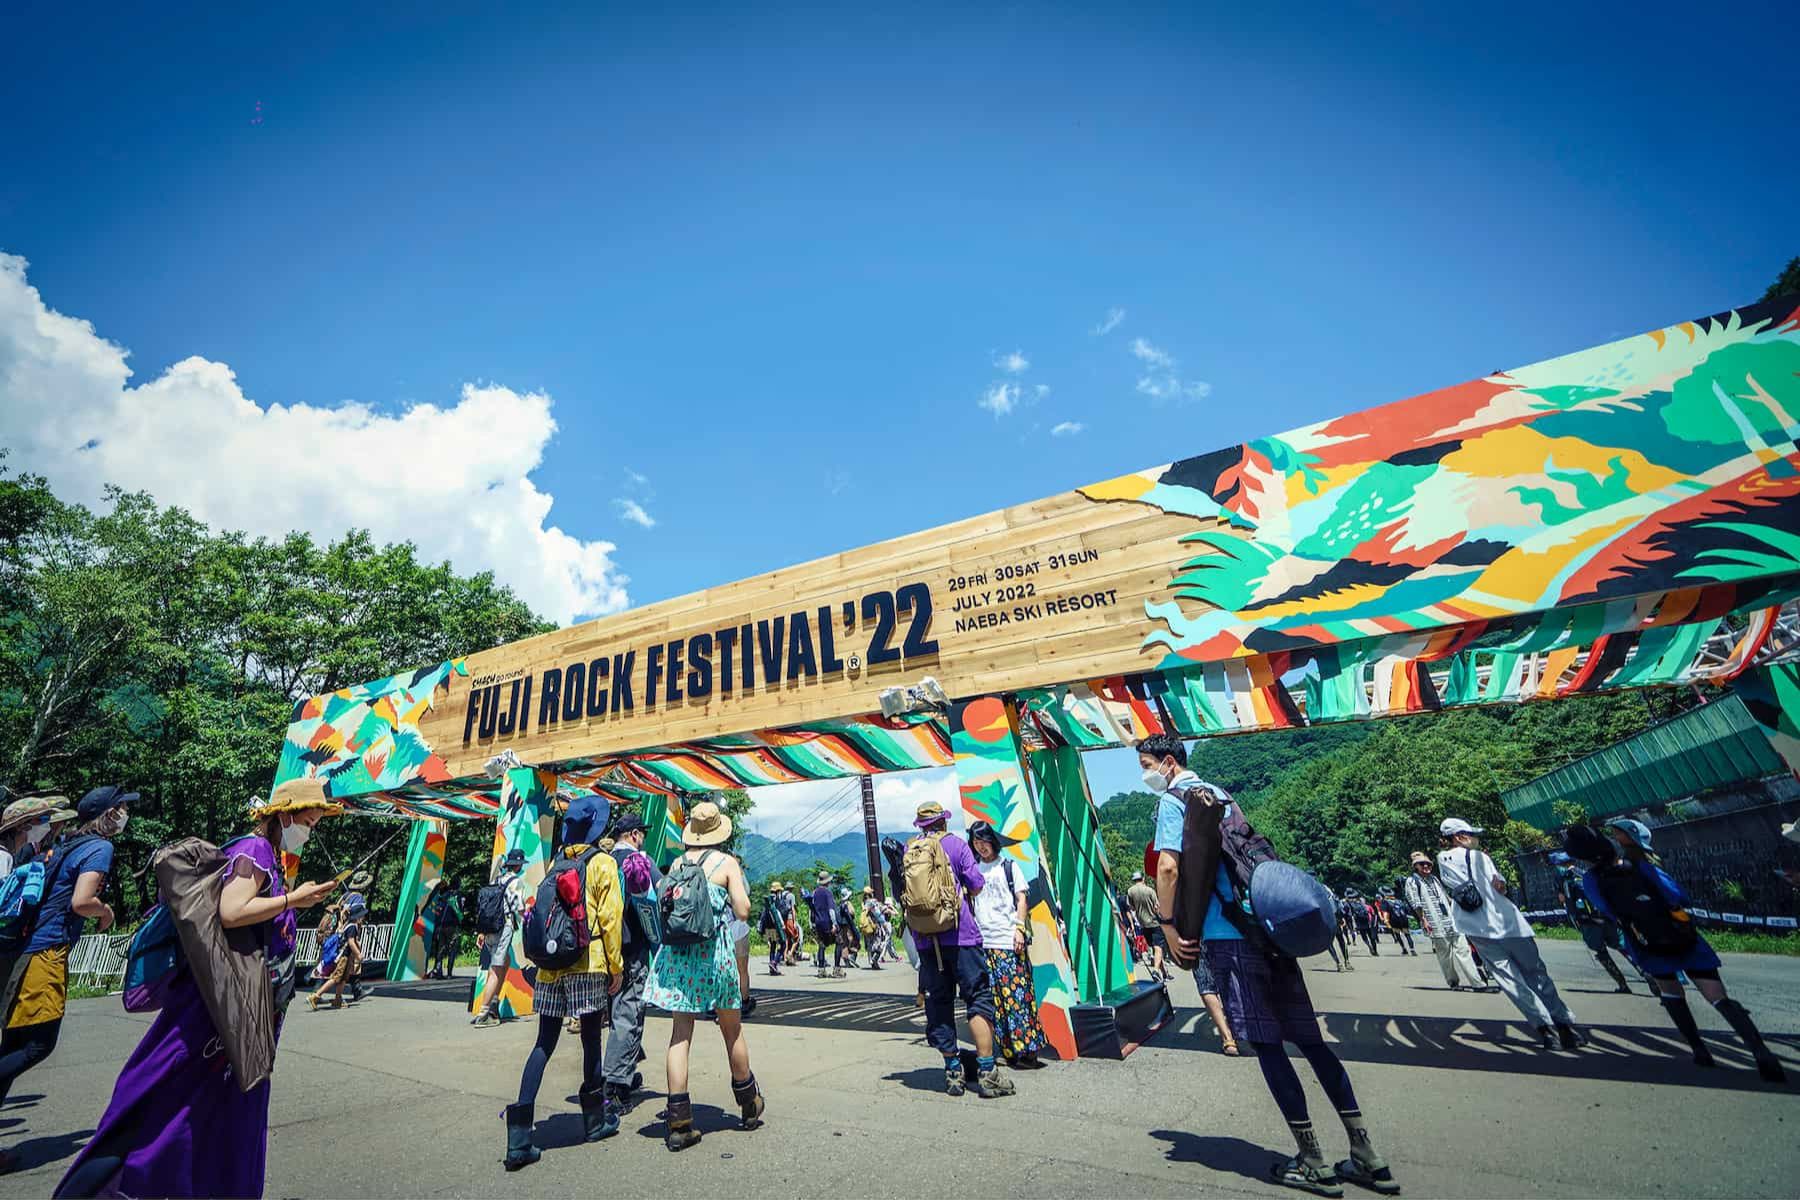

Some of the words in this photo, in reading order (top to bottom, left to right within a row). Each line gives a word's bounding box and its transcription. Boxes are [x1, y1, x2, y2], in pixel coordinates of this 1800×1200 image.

[952, 592, 992, 612] JULY
[996, 583, 1036, 603] 2022
[955, 611, 1011, 633] NAEBA
[1013, 605, 1042, 622] SKI
[1046, 589, 1118, 616] RESORT
[463, 675, 533, 743] FUJI
[538, 650, 636, 726] ROCK
